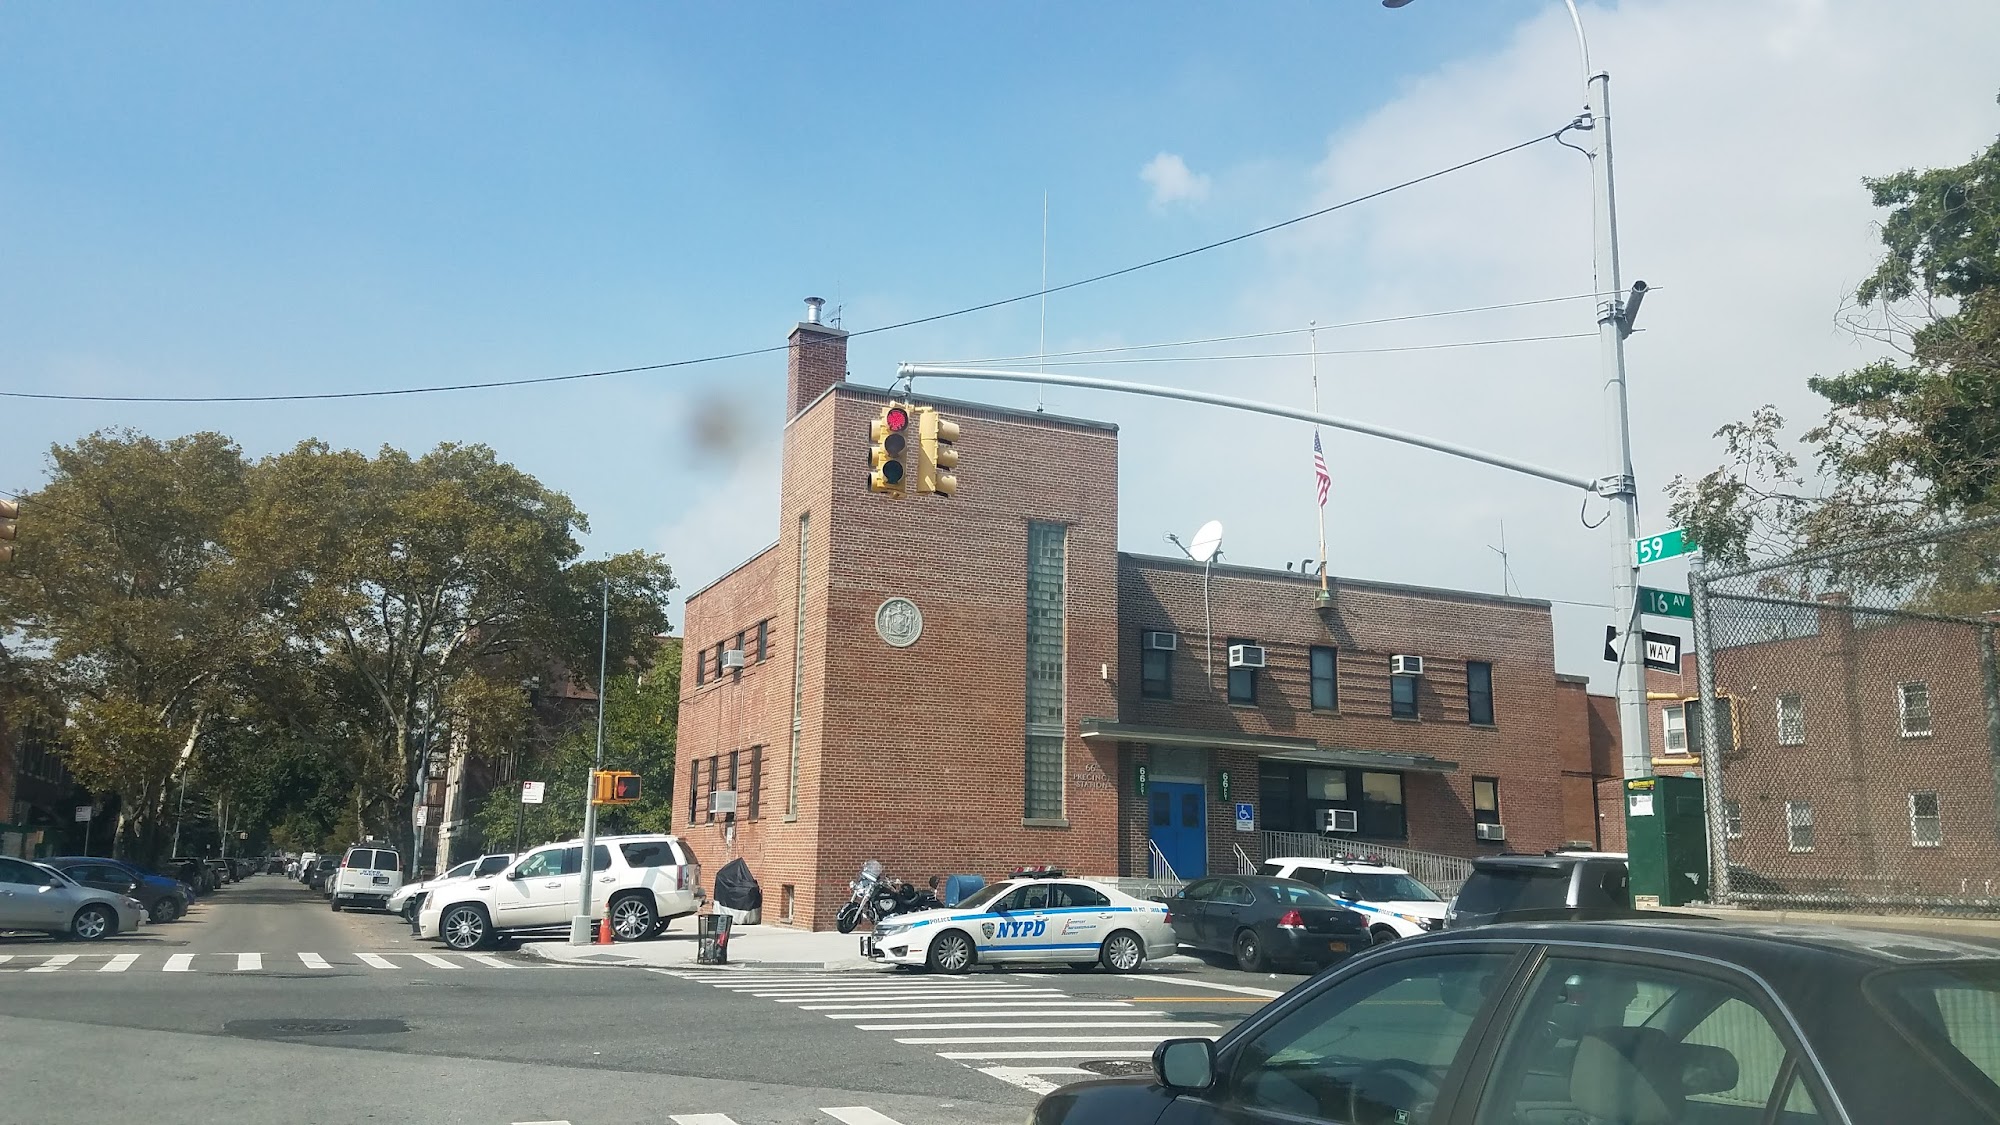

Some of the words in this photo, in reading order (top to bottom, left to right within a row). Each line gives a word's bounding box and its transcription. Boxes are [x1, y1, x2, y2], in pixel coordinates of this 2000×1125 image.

[1640, 537, 1663, 563] 59
[1650, 592, 1668, 613] 16
[1673, 595, 1686, 607] AV
[1650, 643, 1671, 660] WAY
[1139, 767, 1146, 782] 66
[1222, 772, 1229, 788] 66
[930, 916, 951, 924] POLICE
[996, 921, 1046, 938] NYPD
